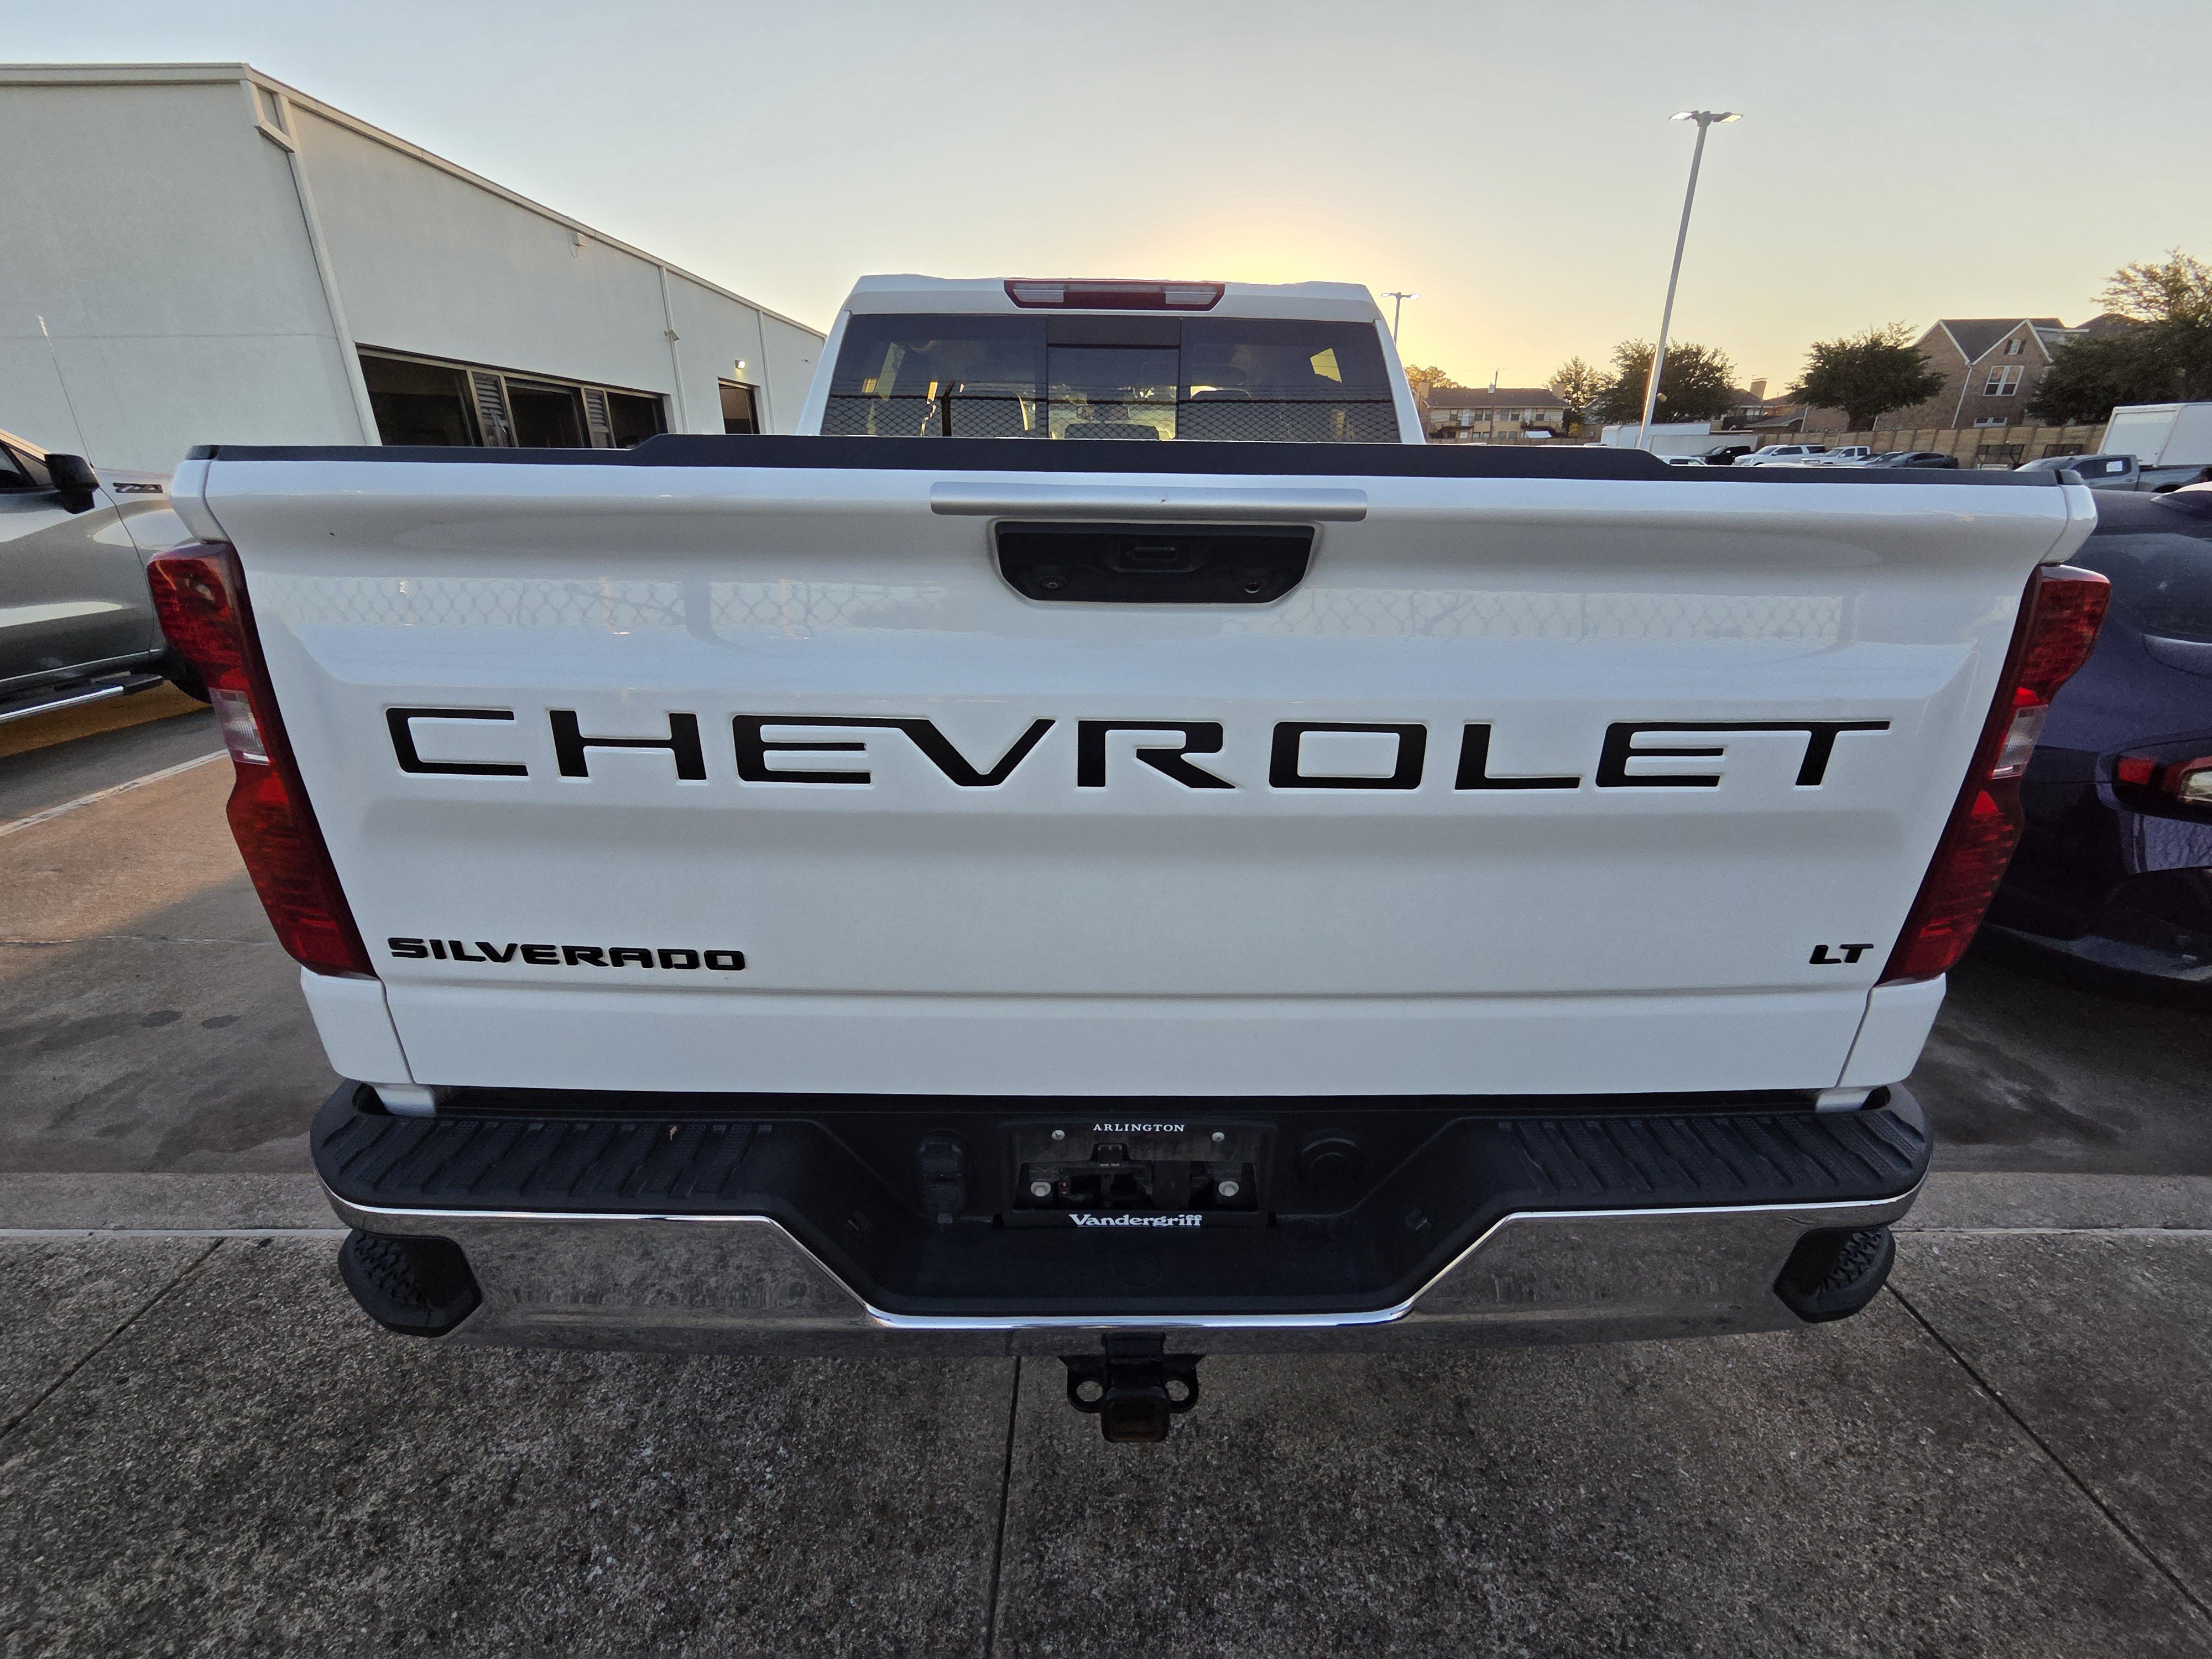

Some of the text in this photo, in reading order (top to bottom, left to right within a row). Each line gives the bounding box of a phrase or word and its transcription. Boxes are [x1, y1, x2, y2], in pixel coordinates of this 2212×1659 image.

[385, 707, 1891, 791] CHEVROLET
[388, 937, 745, 971] SILVERADO
[1809, 943, 1874, 964] LT
[1093, 1123, 1185, 1132] ARLINGTON
[1068, 1214, 1202, 1227] Vandergriff
